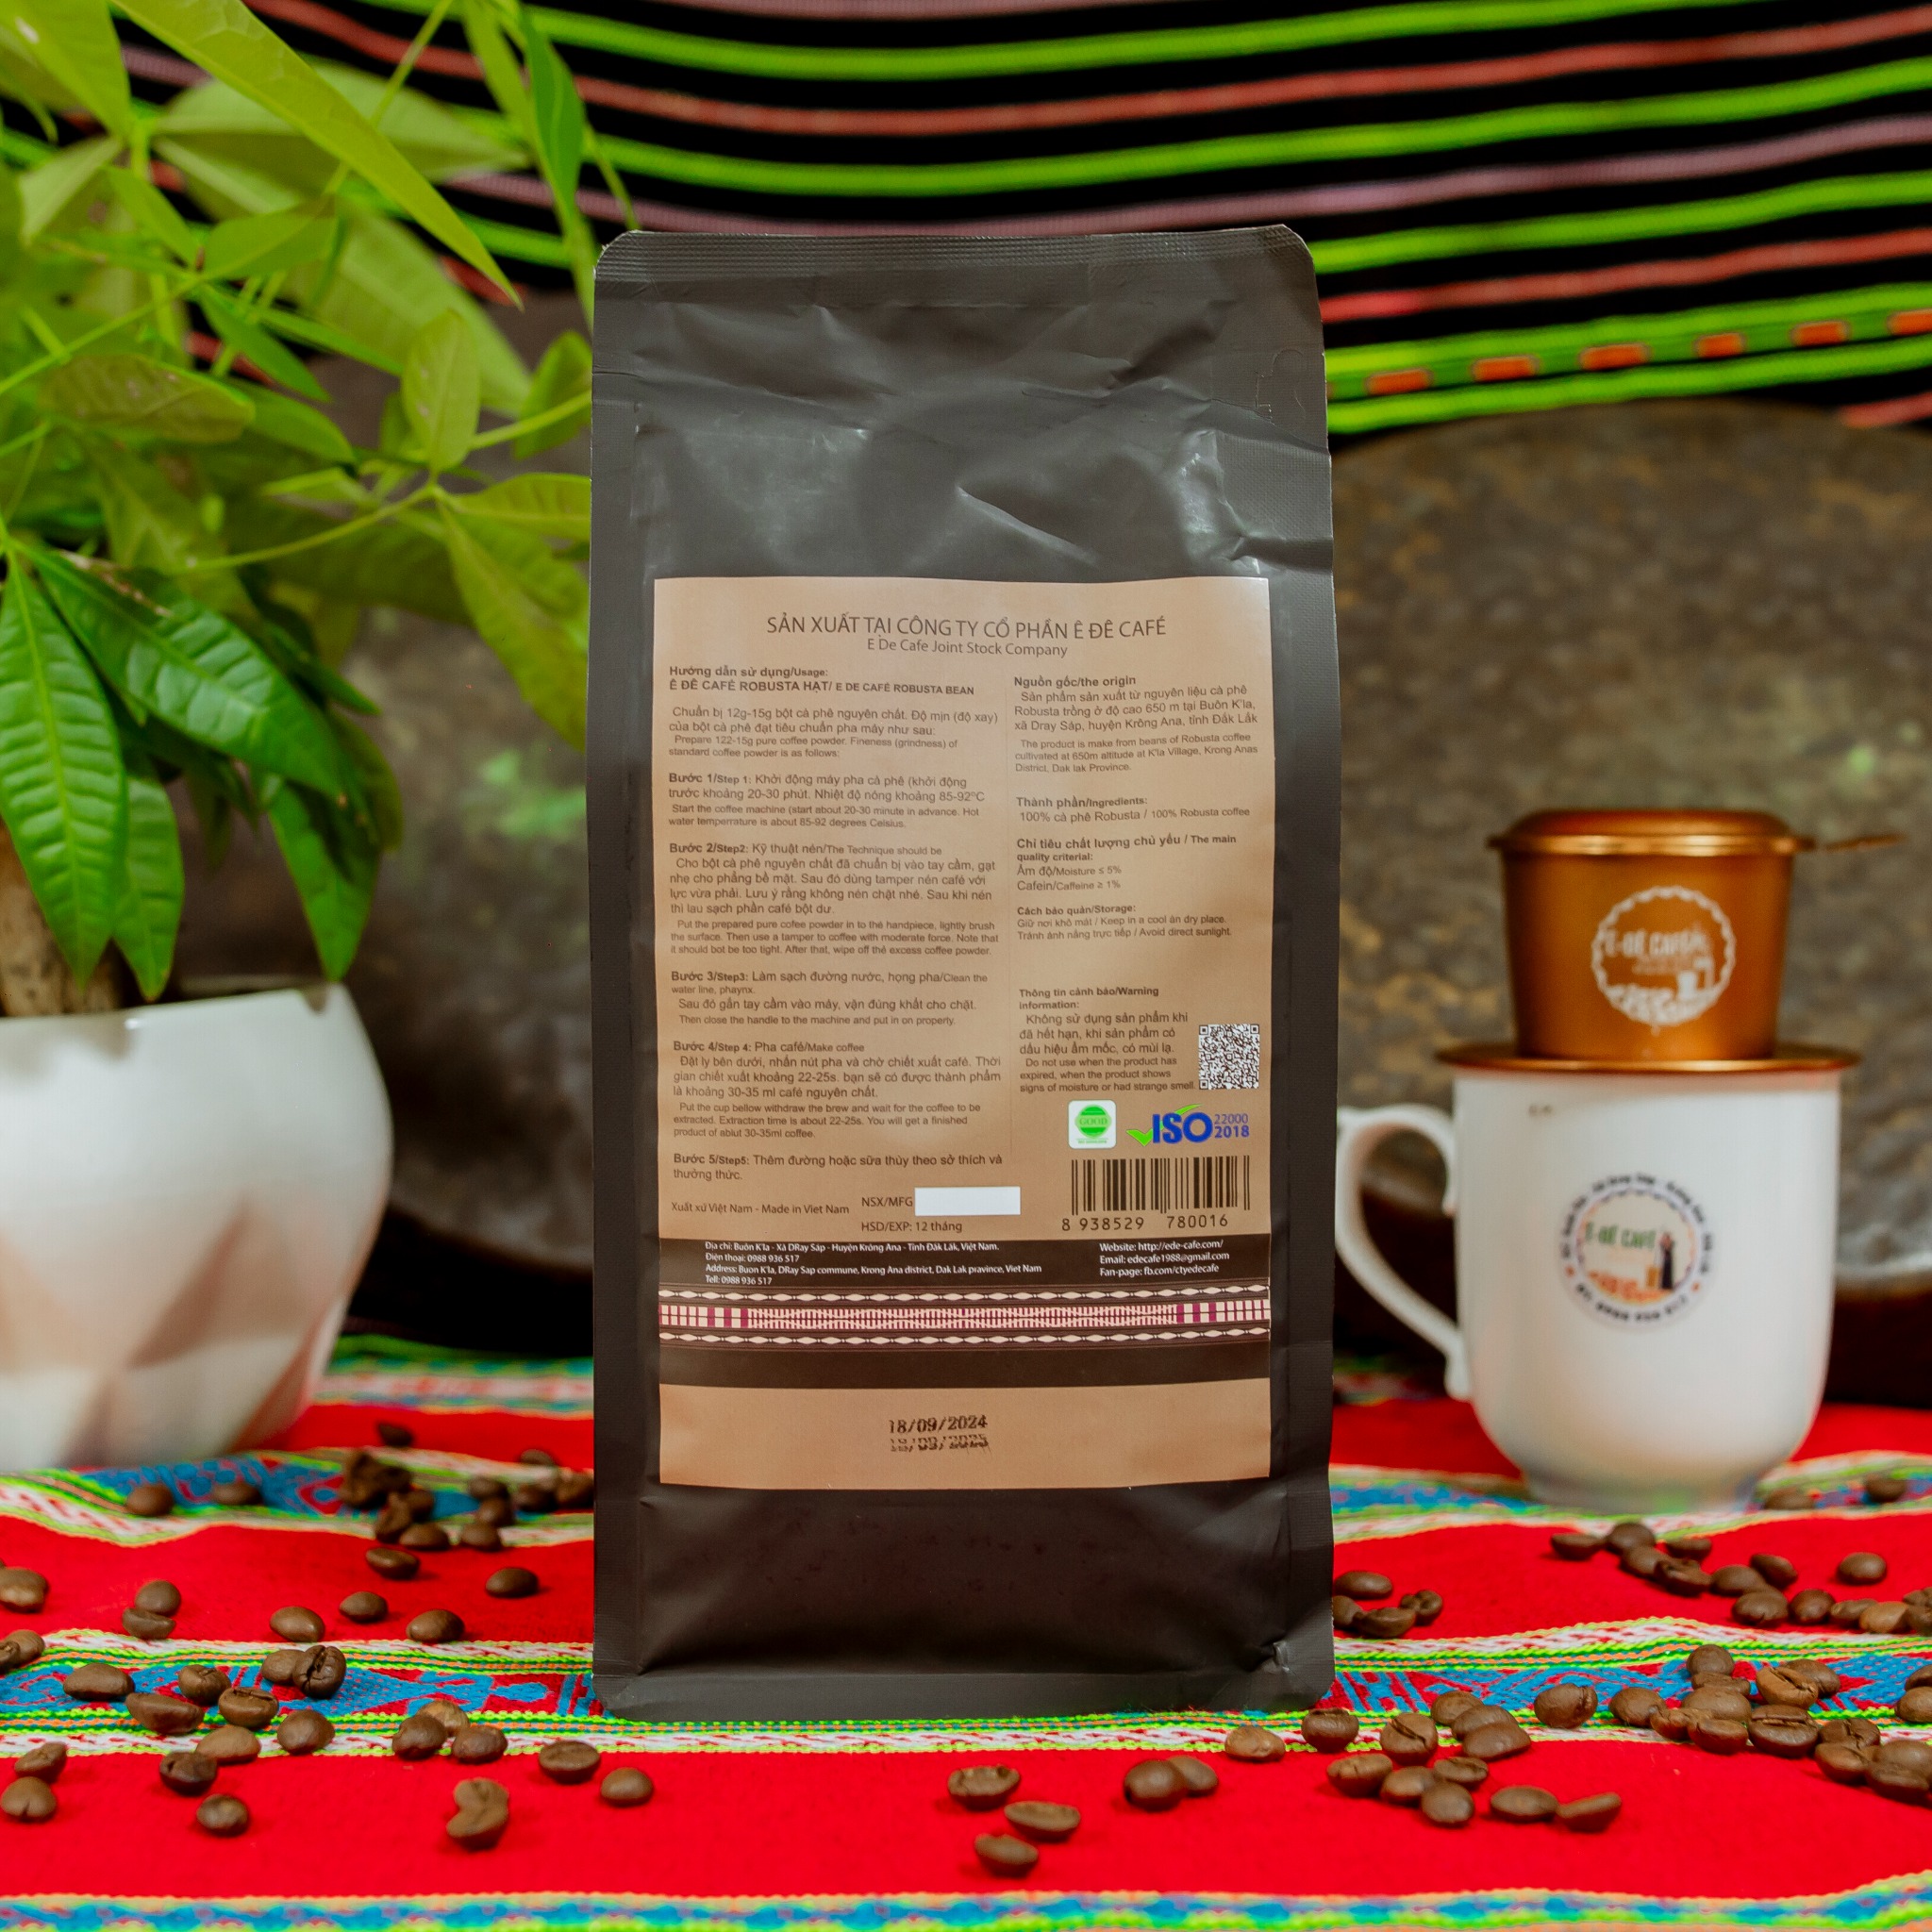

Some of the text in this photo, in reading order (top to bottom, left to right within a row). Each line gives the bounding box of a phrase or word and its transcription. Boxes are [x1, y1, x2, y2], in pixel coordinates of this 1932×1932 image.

[767, 611, 1166, 639] SẢN XUẤT TẠI CÔNG TY CỔ PHẦN Ê ĐÊ CAFÉ
[868, 639, 1067, 658] E De Cafe Joint Stock Company
[740, 680, 799, 691] ROBUSTA
[846, 682, 859, 691] DE
[894, 684, 942, 692] ROBUSTA
[946, 686, 974, 694] BEAN
[1103, 675, 1136, 688] origin
[716, 736, 753, 747] 122-15g
[756, 738, 776, 747] pure
[780, 736, 808, 744] coffee
[811, 737, 848, 748] powder.
[851, 737, 891, 745] Fineness
[895, 738, 946, 750] (grindness)
[949, 739, 957, 747] of
[1022, 739, 1038, 747] The
[1041, 740, 1074, 750] product
[1078, 740, 1085, 748] is
[1116, 738, 1136, 746] from
[1140, 737, 1167, 745] beans
[1182, 734, 1220, 742] Robusta
[1223, 732, 1251, 741] coffee
[843, 774, 863, 788] pha
[1021, 811, 1050, 821] 100%
[1095, 810, 1140, 821] Robusta
[1153, 808, 1176, 817] 100%
[1180, 807, 1219, 817] Robusta
[1222, 807, 1250, 816] coffee
[707, 842, 748, 856] 2/Step2:
[848, 845, 893, 857] Technique
[1017, 852, 1049, 864] quality
[708, 971, 748, 984] 3/Step3:
[708, 1041, 740, 1054] 4/Step
[755, 1041, 776, 1051] Pha
[1025, 1058, 1039, 1066] Do
[1079, 1057, 1104, 1065] when
[1124, 1058, 1158, 1068] product
[1161, 1057, 1176, 1065] has
[1020, 1071, 1057, 1082] expired,
[1106, 1069, 1140, 1081] product
[1021, 1085, 1044, 1094] signs
[1047, 1082, 1056, 1091] of
[1059, 1083, 1098, 1091] moisture
[1114, 1082, 1130, 1091] had
[1134, 1082, 1167, 1092] strange
[1171, 1081, 1197, 1090] smell.
[1152, 1112, 1249, 1144] ISO 22000
[1214, 1125, 1250, 1139] 2018
[730, 1204, 752, 1213] Nam
[762, 1204, 789, 1213] Made
[792, 1205, 801, 1213] in
[804, 1205, 823, 1213] Viet
[825, 1205, 849, 1213] Nam
[862, 1196, 912, 1209] NSX/MFG
[862, 1222, 911, 1234] HSD/EXP:
[916, 1221, 927, 1230] 12
[1061, 1214, 1228, 1231] 8 938529 780016
[1100, 1242, 1136, 1252] Website:
[1100, 1255, 1125, 1263] Email:
[1100, 1266, 1141, 1277] Fan-page:
[722, 1275, 740, 1284] 0988
[889, 1414, 988, 1433] 18/09/2024
